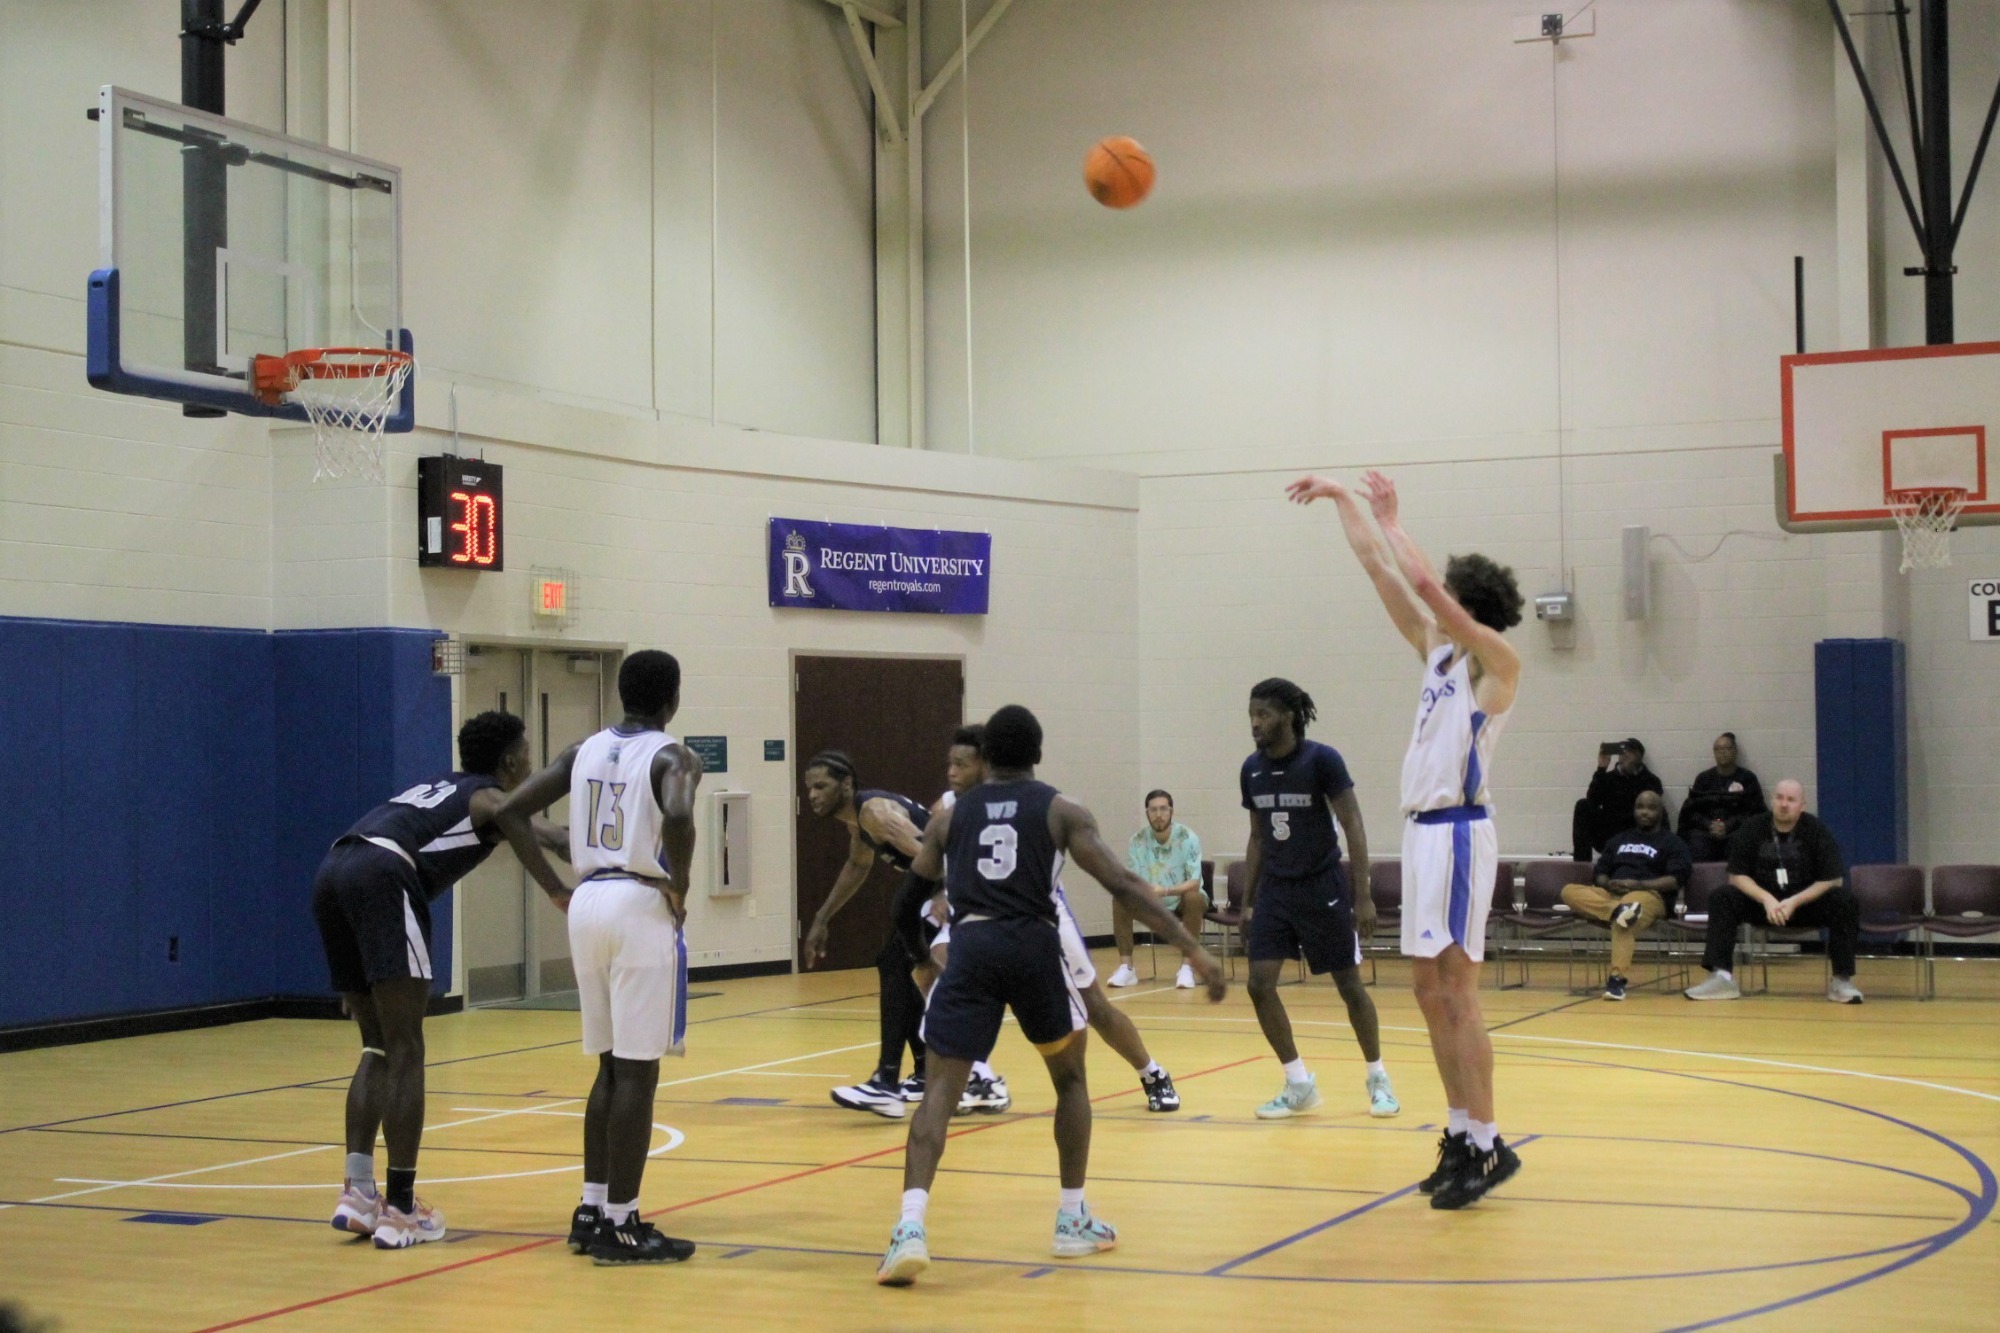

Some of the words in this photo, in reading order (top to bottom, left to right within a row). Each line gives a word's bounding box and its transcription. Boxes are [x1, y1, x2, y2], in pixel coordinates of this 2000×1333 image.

[452, 492, 493, 563] 30
[782, 549, 815, 597] R
[820, 548, 886, 571] REGENT
[890, 552, 984, 576] UNIVERSITY
[543, 582, 563, 609] EXIT
[868, 578, 941, 594] regentroyals.com
[1971, 582, 2000, 596] CO
[586, 778, 626, 852] 13
[1271, 812, 1291, 841] 5
[977, 823, 1018, 880] 3
